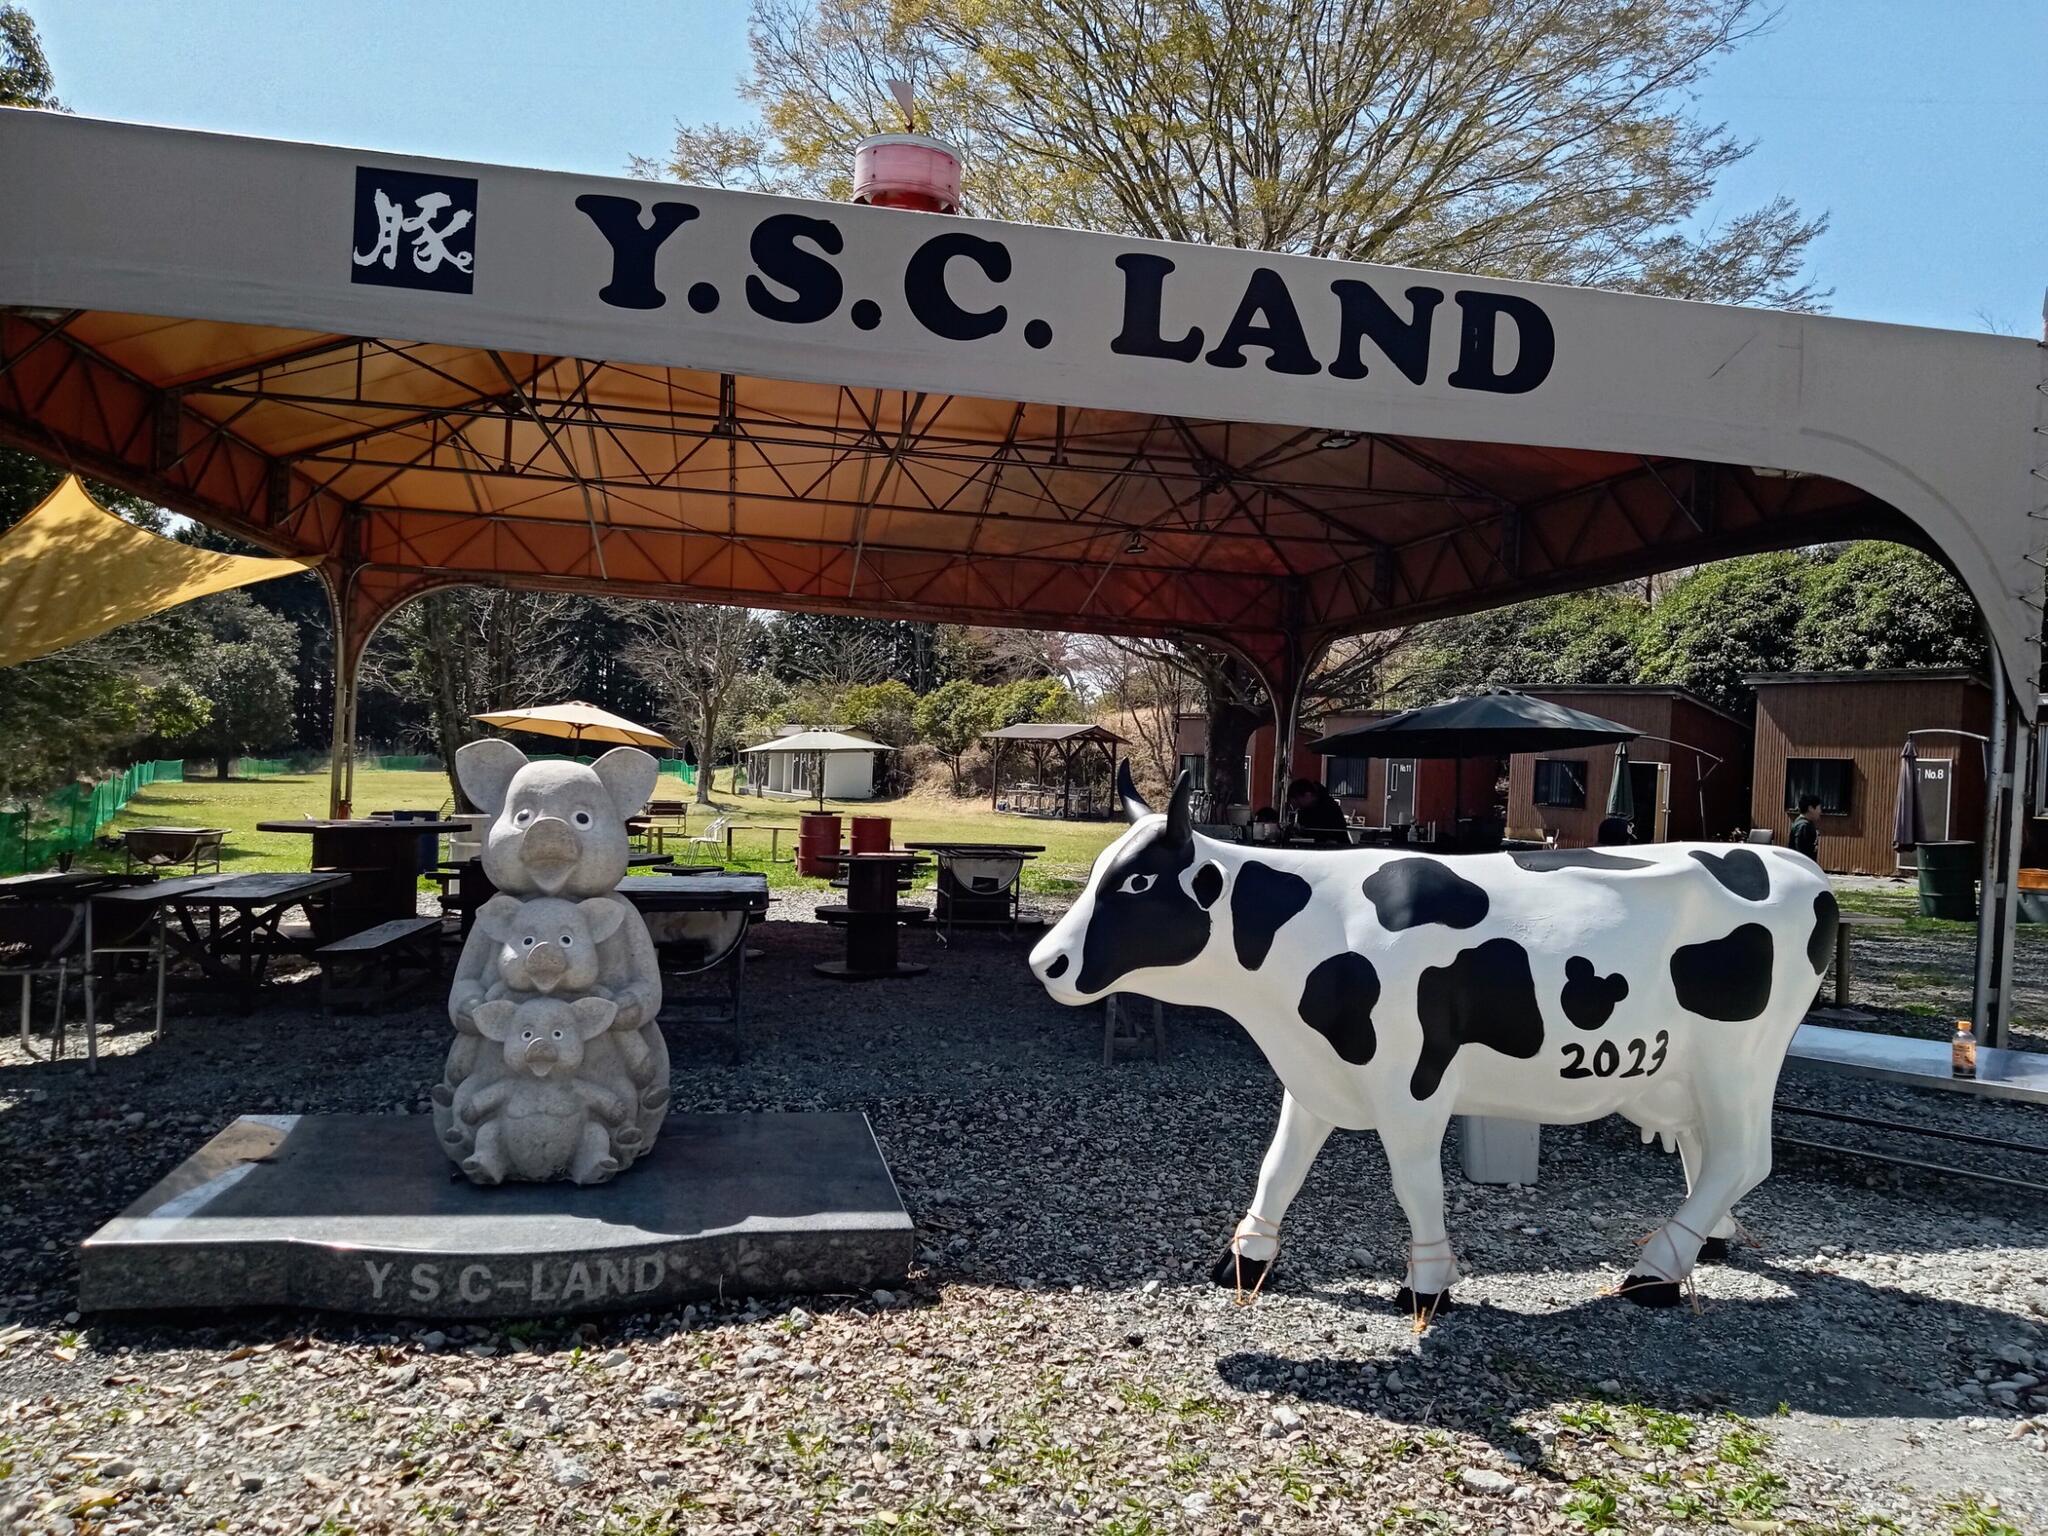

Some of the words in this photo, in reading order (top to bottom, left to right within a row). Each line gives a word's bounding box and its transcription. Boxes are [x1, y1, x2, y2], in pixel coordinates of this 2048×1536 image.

[574, 193, 1053, 350] Y.S.C.
[1110, 252, 1556, 395] LAND
[1924, 768, 1945, 780] No.8
[1559, 1029, 1670, 1080] 2023
